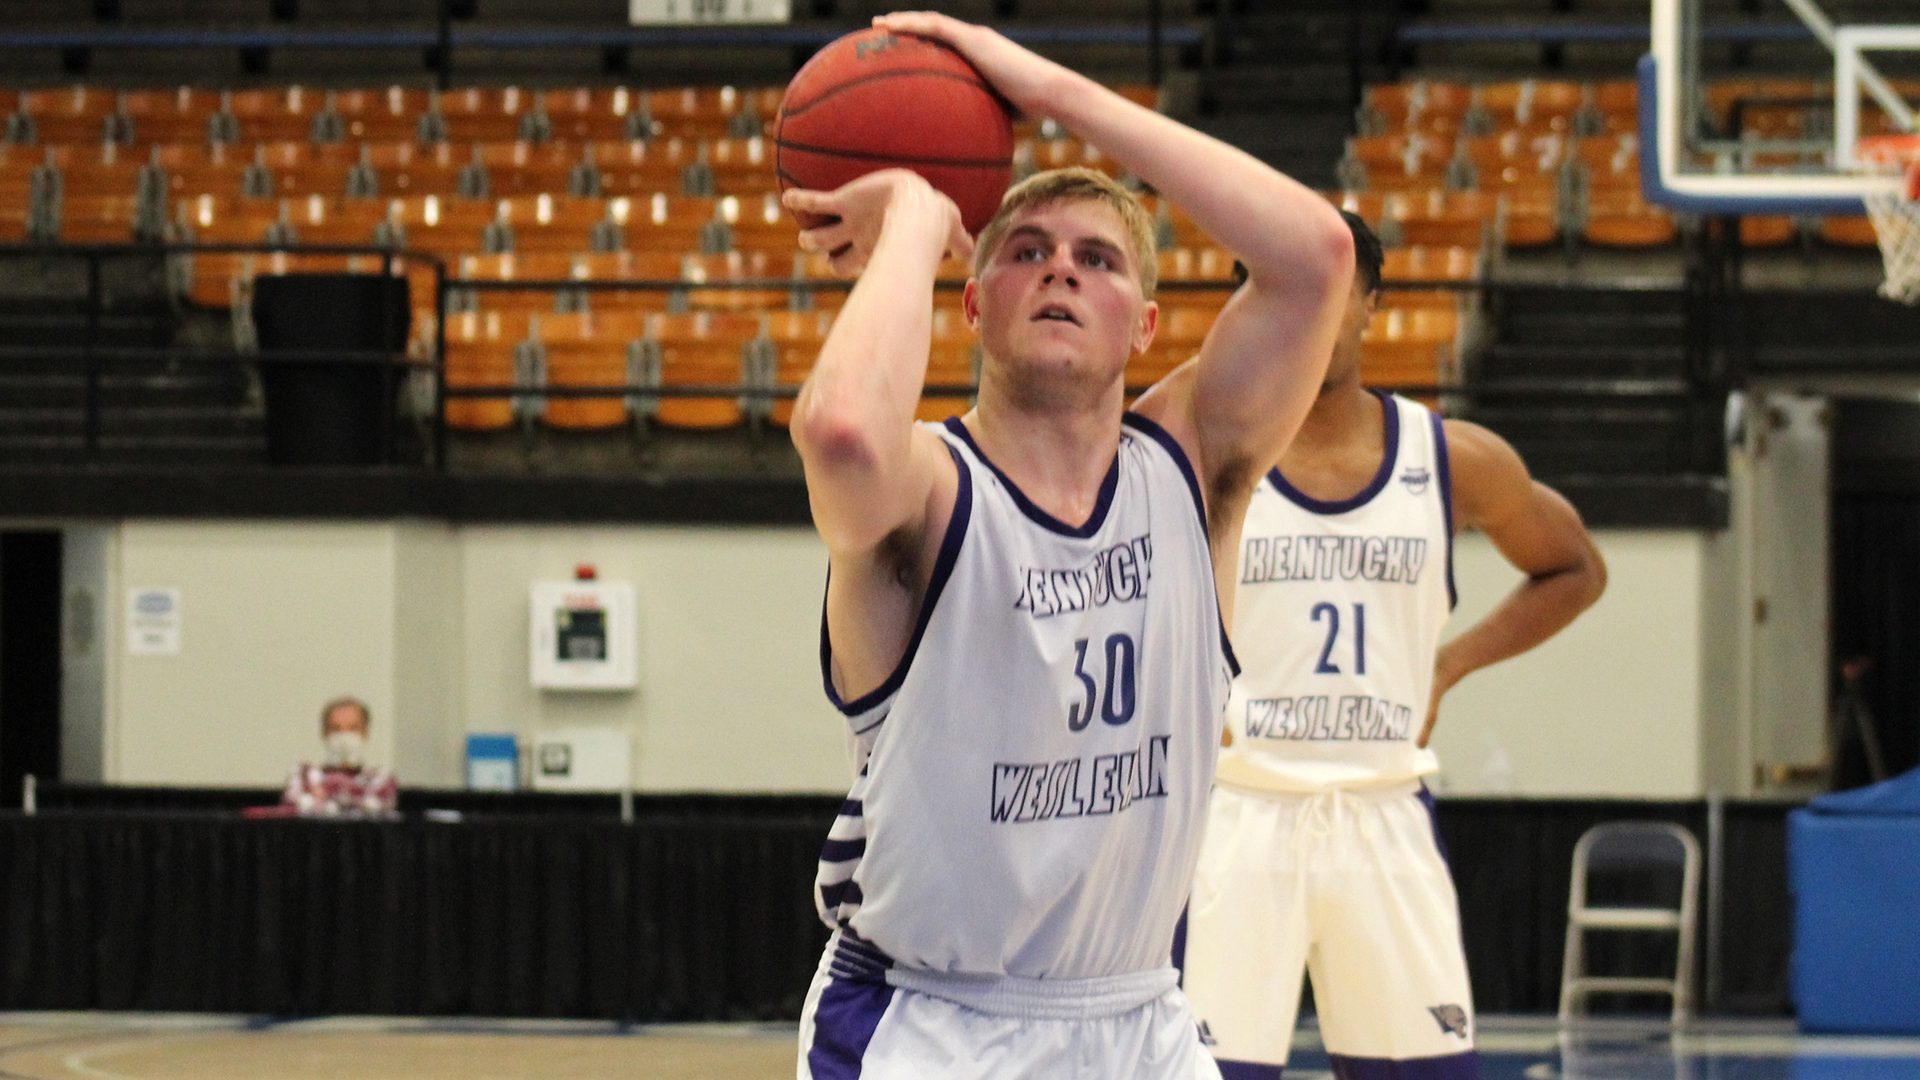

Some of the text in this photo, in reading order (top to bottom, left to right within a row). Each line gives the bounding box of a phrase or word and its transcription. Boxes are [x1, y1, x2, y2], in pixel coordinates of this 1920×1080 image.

[1241, 534, 1427, 585] KENTUCKY
[1310, 602, 1366, 675] 21
[1067, 632, 1136, 732] 30
